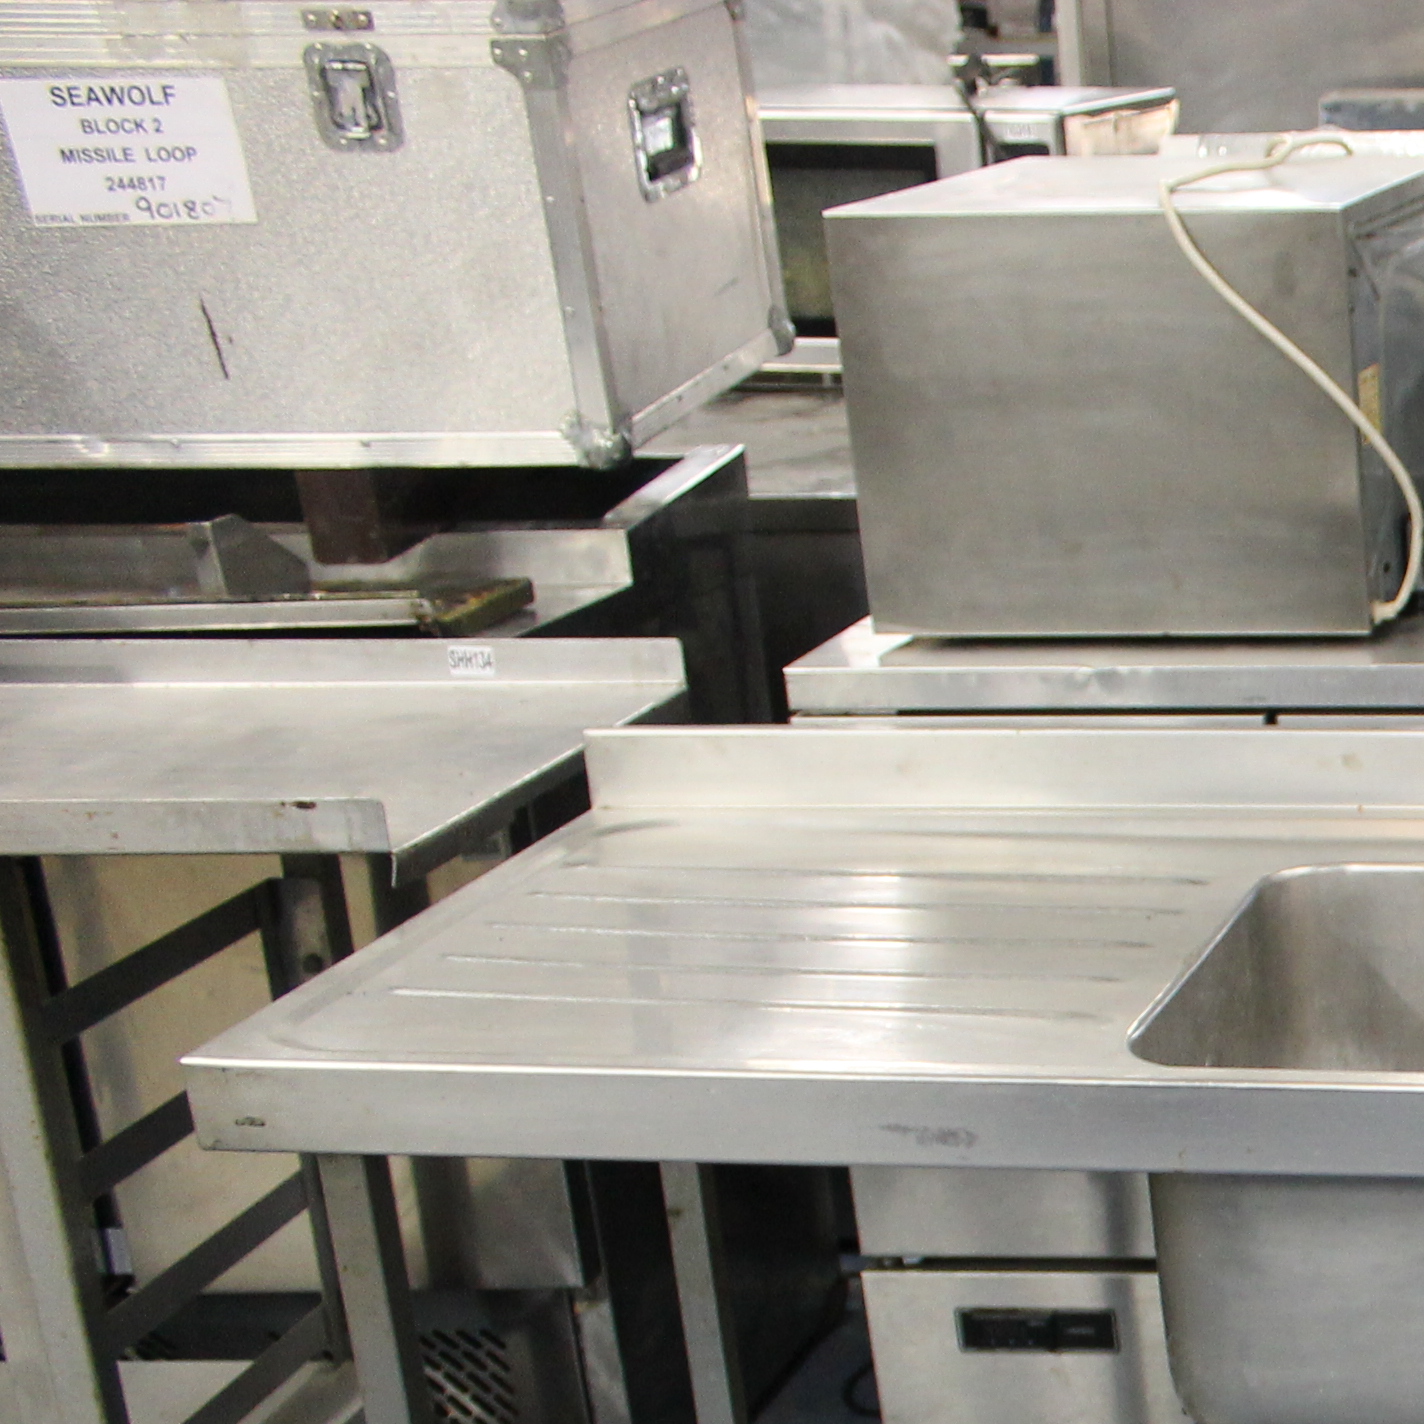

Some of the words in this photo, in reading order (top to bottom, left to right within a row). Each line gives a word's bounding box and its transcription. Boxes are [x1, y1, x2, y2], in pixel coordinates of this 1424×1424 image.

[49, 84, 176, 108] SEAWOLF
[80, 117, 147, 135] BLOCK
[152, 117, 164, 134] 2
[59, 147, 136, 164] MISSILE
[144, 146, 198, 163] LOOP
[104, 175, 166, 192] 244817
[36, 213, 76, 225] SERIAL
[80, 212, 130, 224] NUMBER
